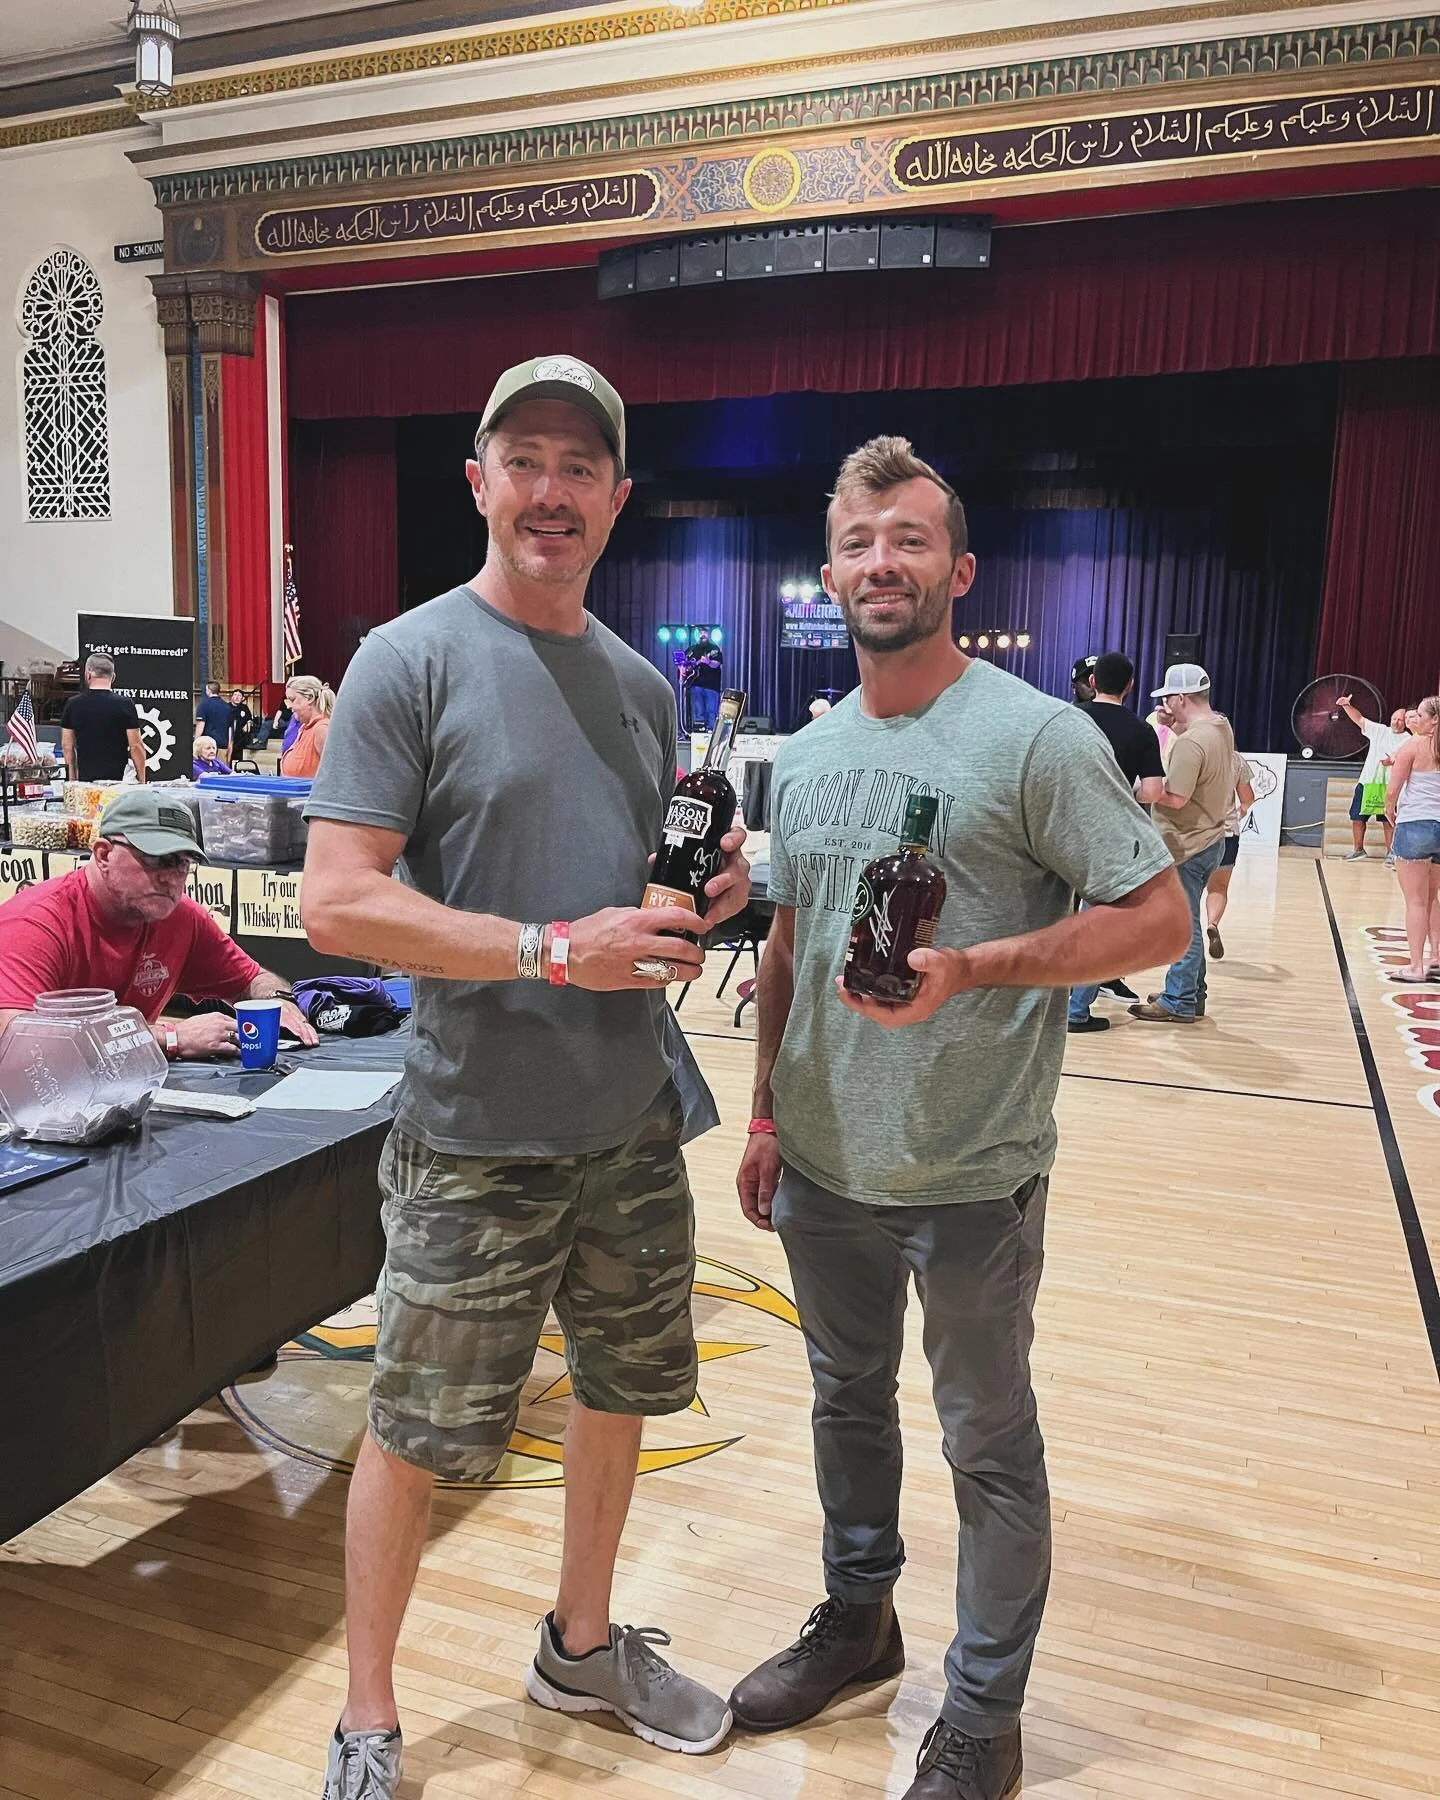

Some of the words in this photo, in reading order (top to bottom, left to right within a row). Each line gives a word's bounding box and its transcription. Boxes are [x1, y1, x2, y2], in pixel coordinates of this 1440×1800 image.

[119, 247, 130, 259] NO
[133, 242, 163, 256] SMOKIN
[113, 646, 129, 656] get
[139, 689, 188, 700] HAMMER
[824, 838, 847, 848] EST.
[184, 870, 225, 905] rbon
[261, 873, 278, 902] Try
[280, 880, 297, 898] our
[648, 892, 677, 907] RYE
[240, 902, 281, 933] Whiskey
[241, 1042, 262, 1051] pepsi
